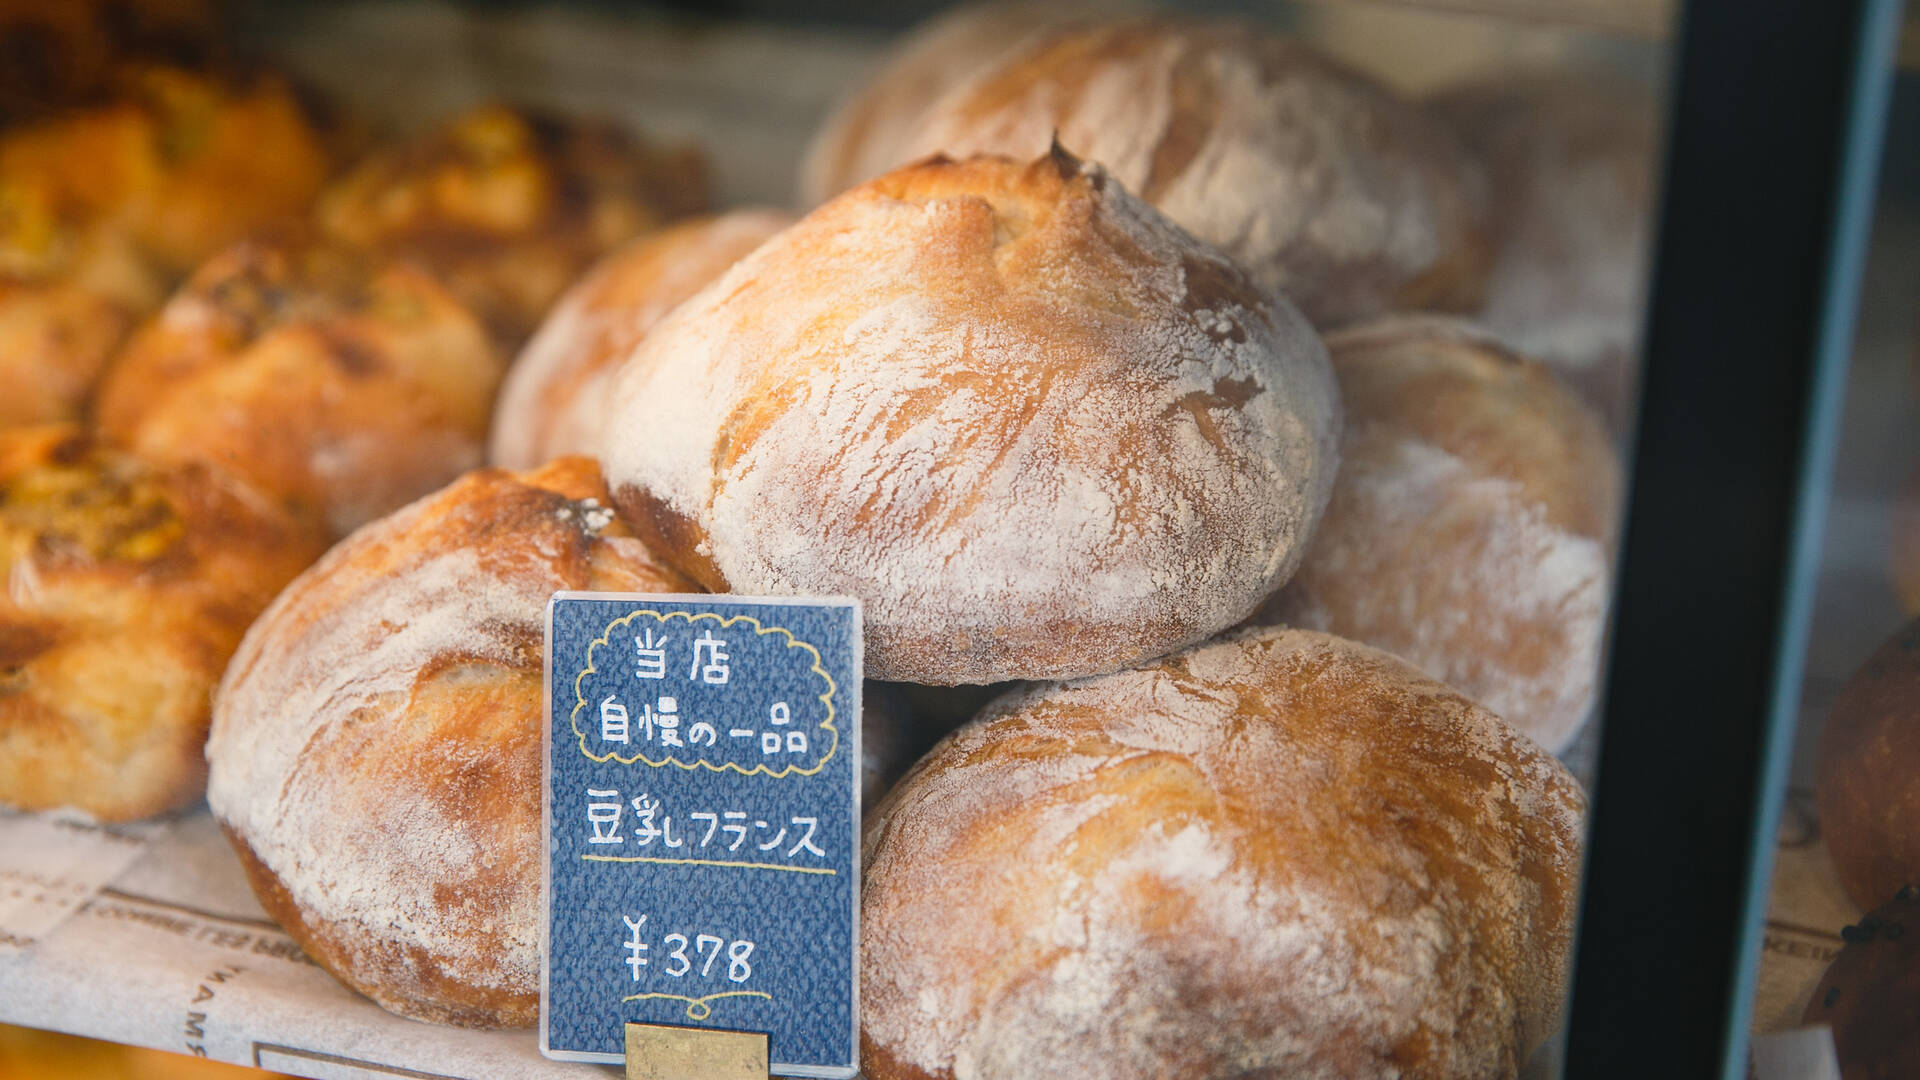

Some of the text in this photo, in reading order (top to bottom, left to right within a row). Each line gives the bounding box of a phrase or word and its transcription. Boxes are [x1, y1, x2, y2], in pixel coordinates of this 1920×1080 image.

[634, 628, 731, 685] 当店
[600, 695, 808, 754] 自慢の一品
[586, 788, 826, 858] 豆乳フランス
[623, 914, 755, 983] ¥378
